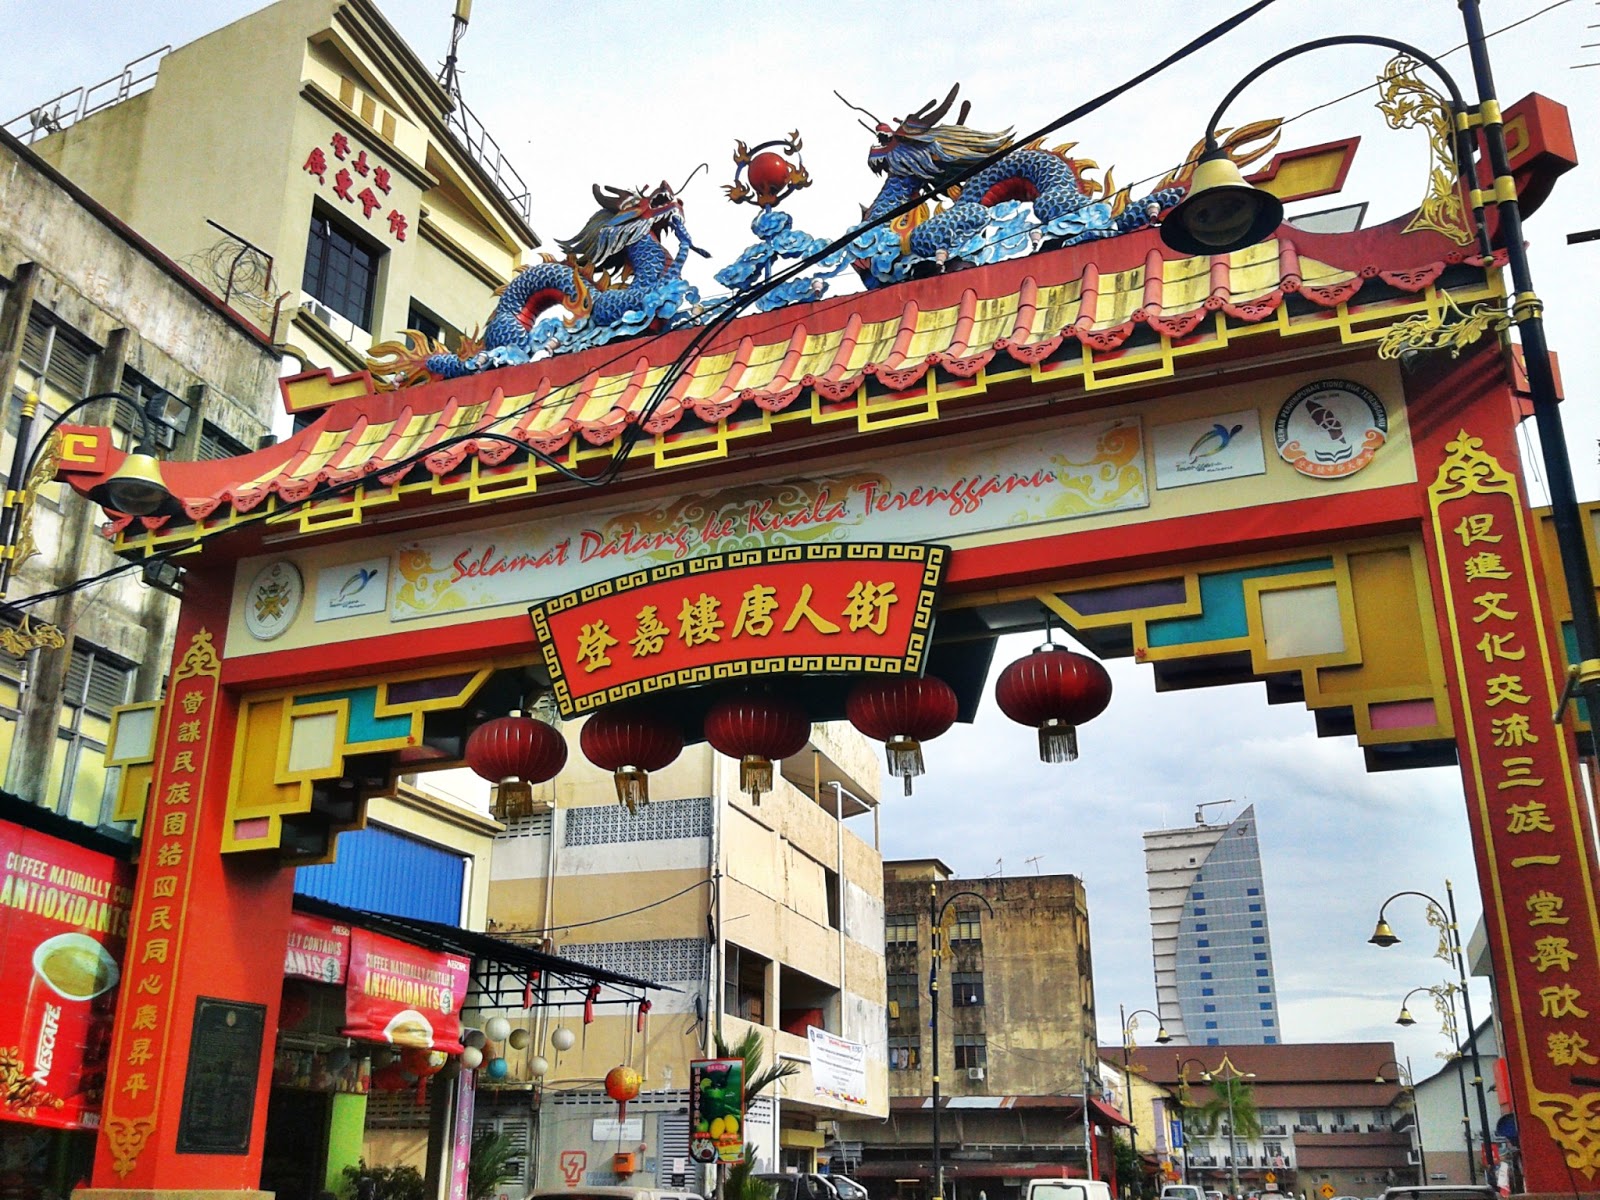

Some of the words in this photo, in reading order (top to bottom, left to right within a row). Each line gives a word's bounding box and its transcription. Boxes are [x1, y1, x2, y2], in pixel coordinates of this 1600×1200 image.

[1322, 381, 1344, 389] TIONG
[1345, 383, 1360, 392] HUA
[450, 540, 568, 583] Selamat
[580, 526, 692, 562] Datang
[701, 512, 732, 541] ke
[748, 488, 846, 534] Kuala
[857, 468, 1057, 517] Terengganu
[576, 580, 898, 673] 登嘉樓唐人街
[6, 851, 48, 880] COFFEE
[49, 865, 112, 899] NATURALLY
[366, 953, 389, 972] COFFEE
[390, 957, 426, 980] NATURALLY
